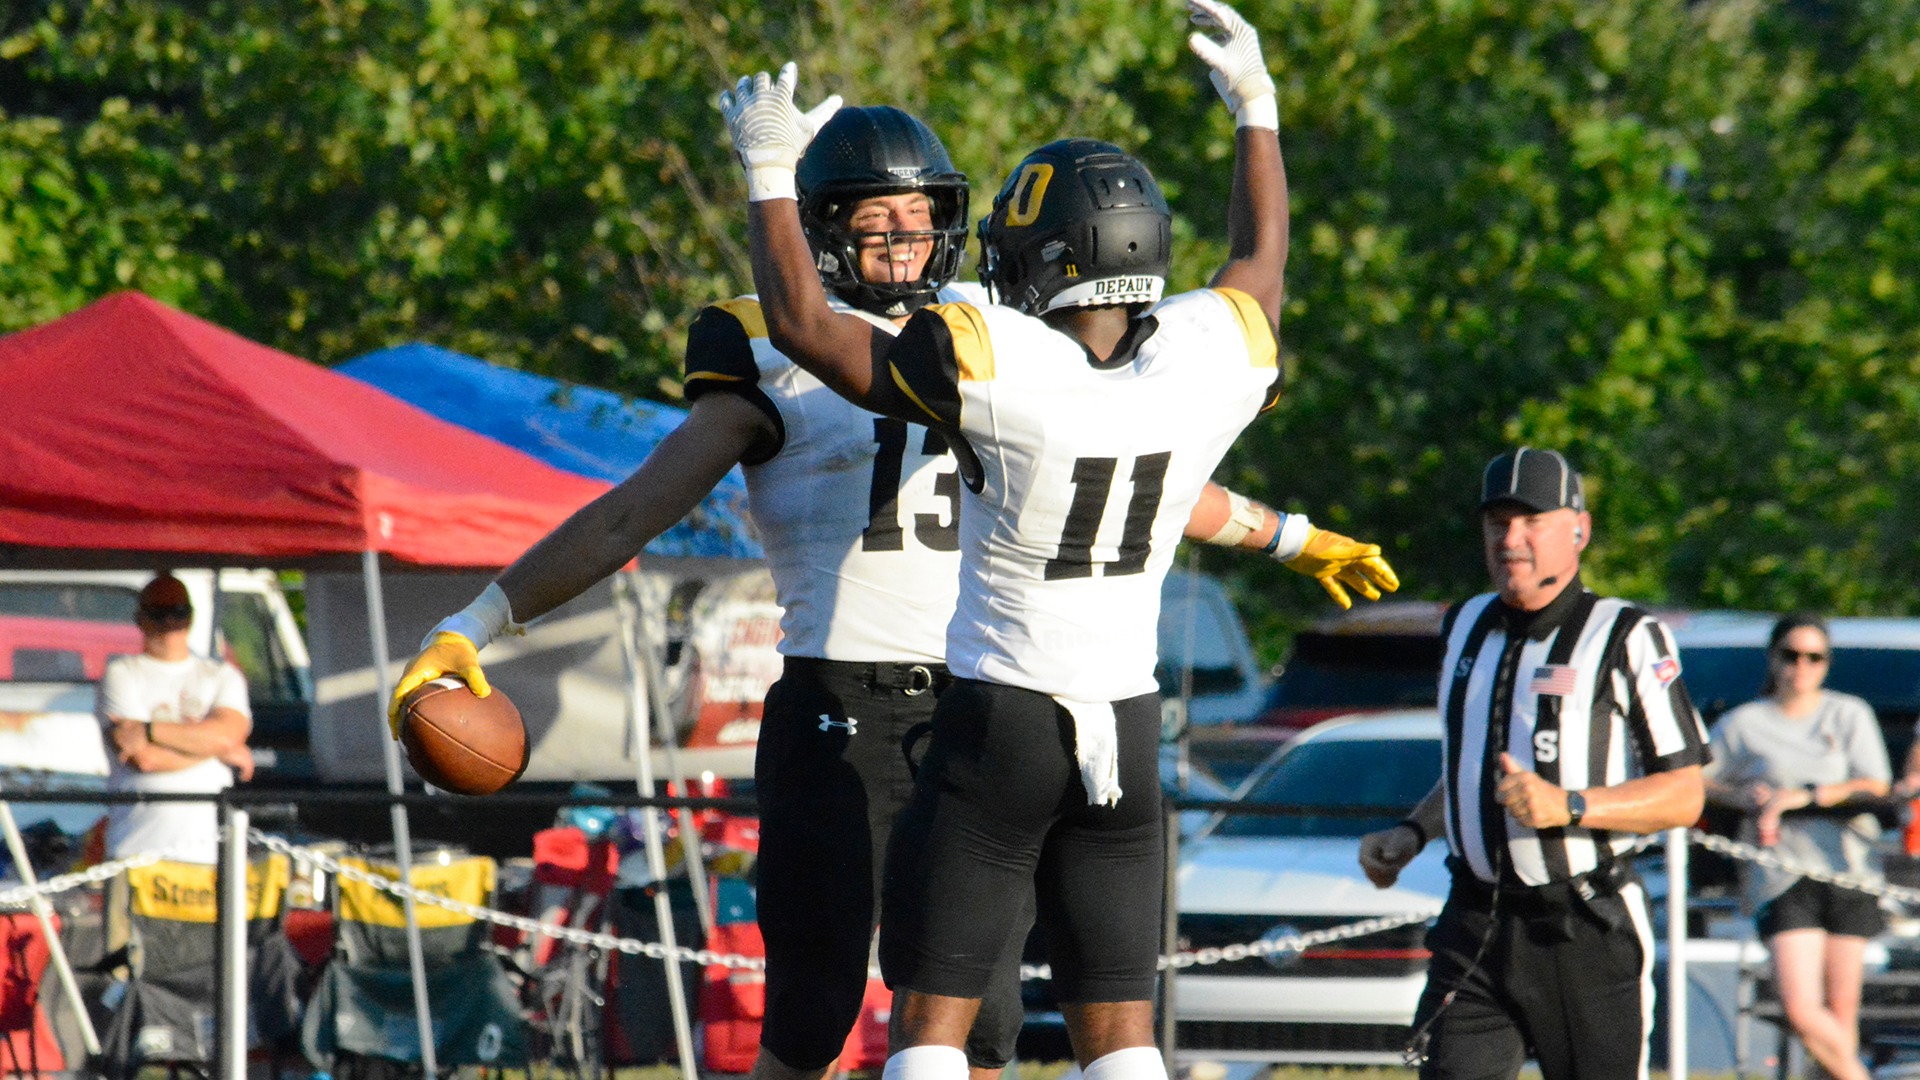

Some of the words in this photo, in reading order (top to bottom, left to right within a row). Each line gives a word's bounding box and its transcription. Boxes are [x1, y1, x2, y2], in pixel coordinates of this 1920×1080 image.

[1065, 264, 1079, 277] 11
[1095, 278, 1153, 295] DEPAUW
[862, 417, 961, 552] 13
[1044, 451, 1172, 581] 11
[1534, 730, 1559, 763] S
